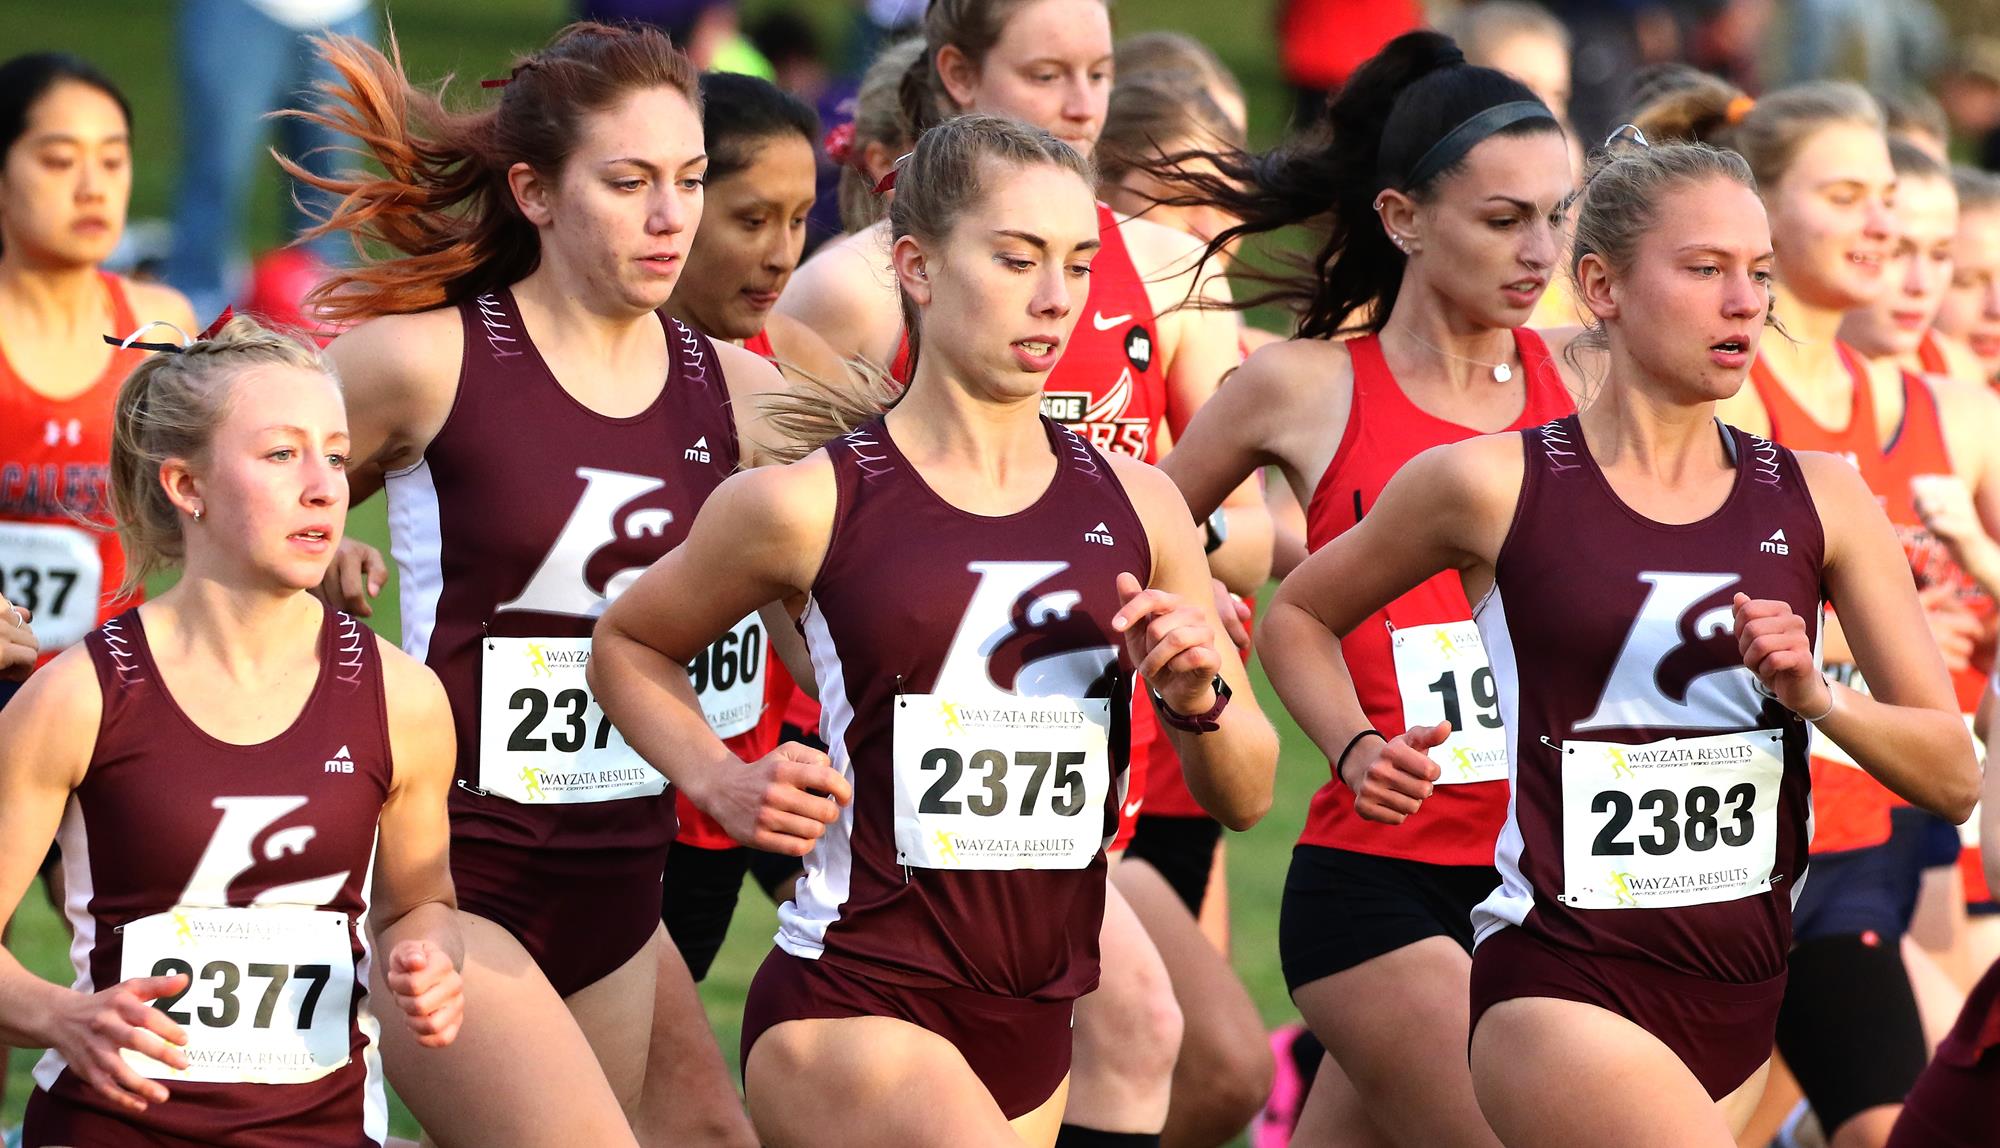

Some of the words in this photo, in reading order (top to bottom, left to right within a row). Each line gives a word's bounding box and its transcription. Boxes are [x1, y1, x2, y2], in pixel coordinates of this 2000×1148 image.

[0, 566, 78, 617] 37
[507, 688, 618, 753] 237
[960, 709, 1026, 722] WAYZATA
[1031, 711, 1084, 724] RESULTS
[1627, 749, 1693, 763] WAYZATA
[1698, 744, 1753, 761] RESULTS
[540, 772, 597, 786] WAYZATA
[599, 768, 645, 783] RESULTS
[918, 747, 1087, 817] 2375
[1590, 782, 1757, 856] 2383
[955, 838, 1020, 851] WAYZATA
[1024, 838, 1075, 851] RESULTS
[1629, 875, 1695, 890] WAYZATA
[1699, 868, 1748, 886] RESULTS
[151, 957, 331, 1030] 2377
